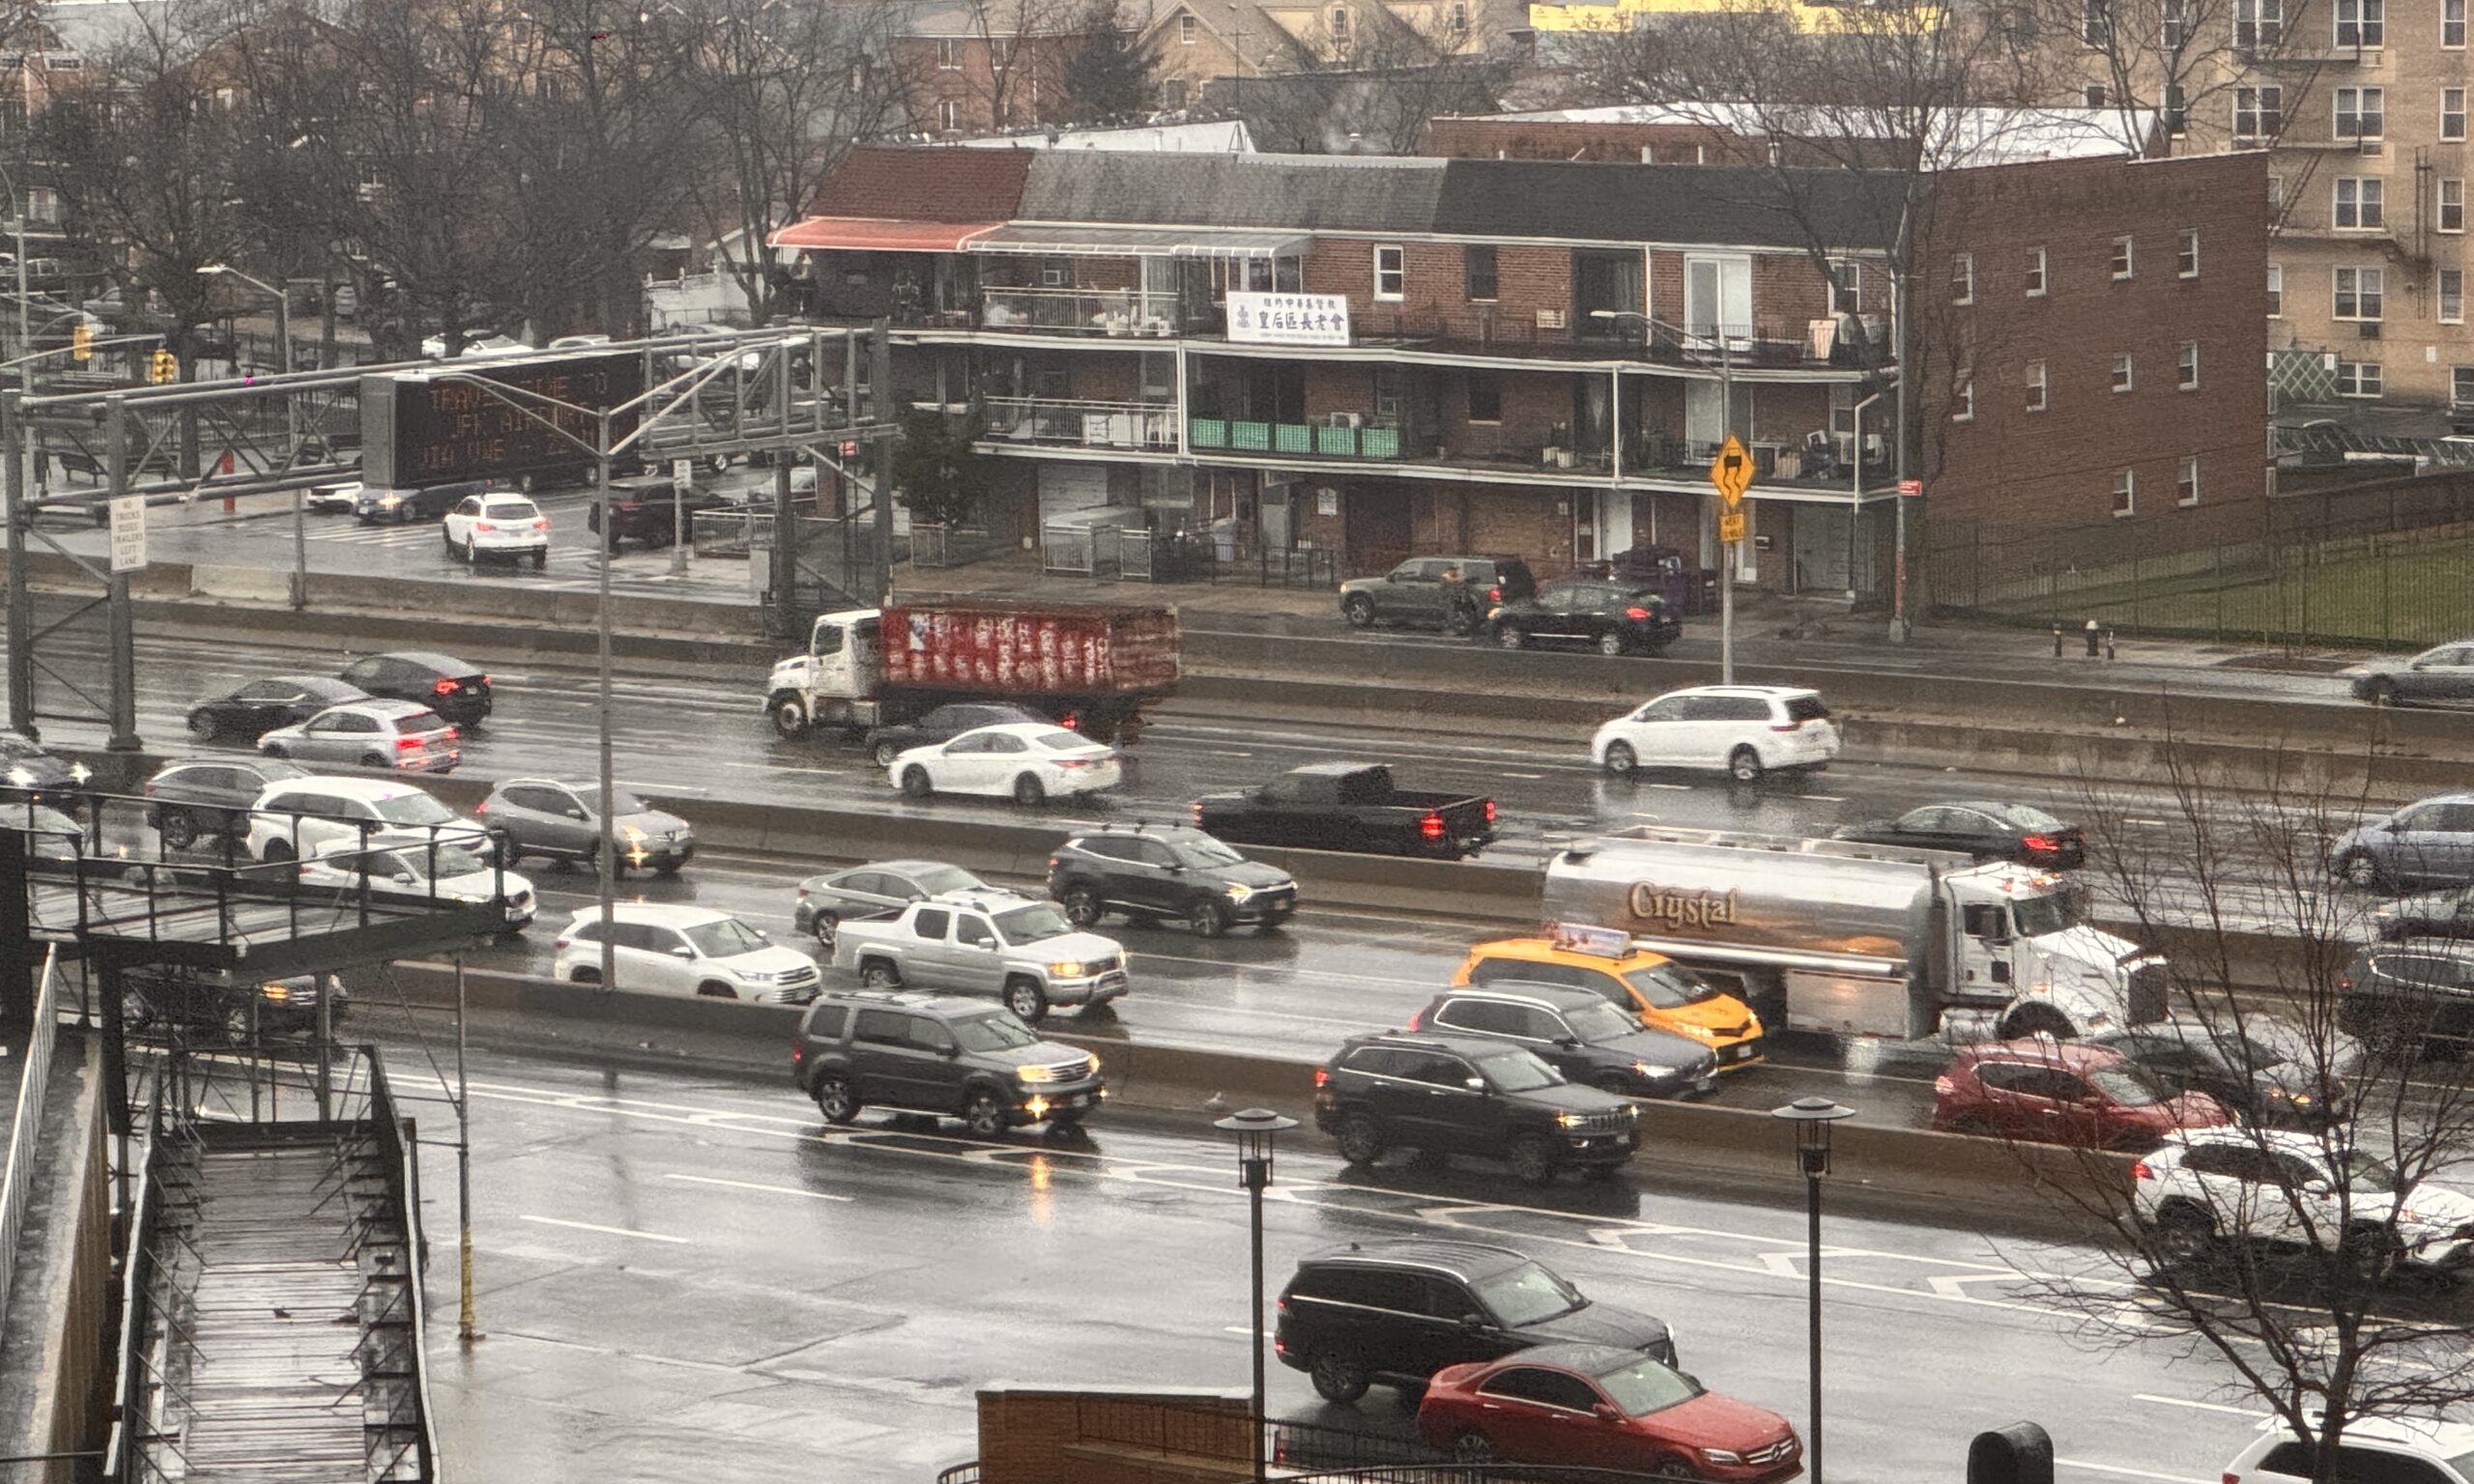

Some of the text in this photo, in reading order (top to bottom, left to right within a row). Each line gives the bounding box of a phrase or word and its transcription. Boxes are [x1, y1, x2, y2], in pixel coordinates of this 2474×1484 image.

[1259, 311, 1344, 330] 皇后區長老會
[451, 412, 487, 439] JFK
[115, 511, 141, 521] TRUCKS
[113, 532, 143, 543] TRAILERS
[120, 544, 136, 556] LEFT
[120, 556, 137, 567] LANE
[1628, 880, 1738, 929] Crystal
